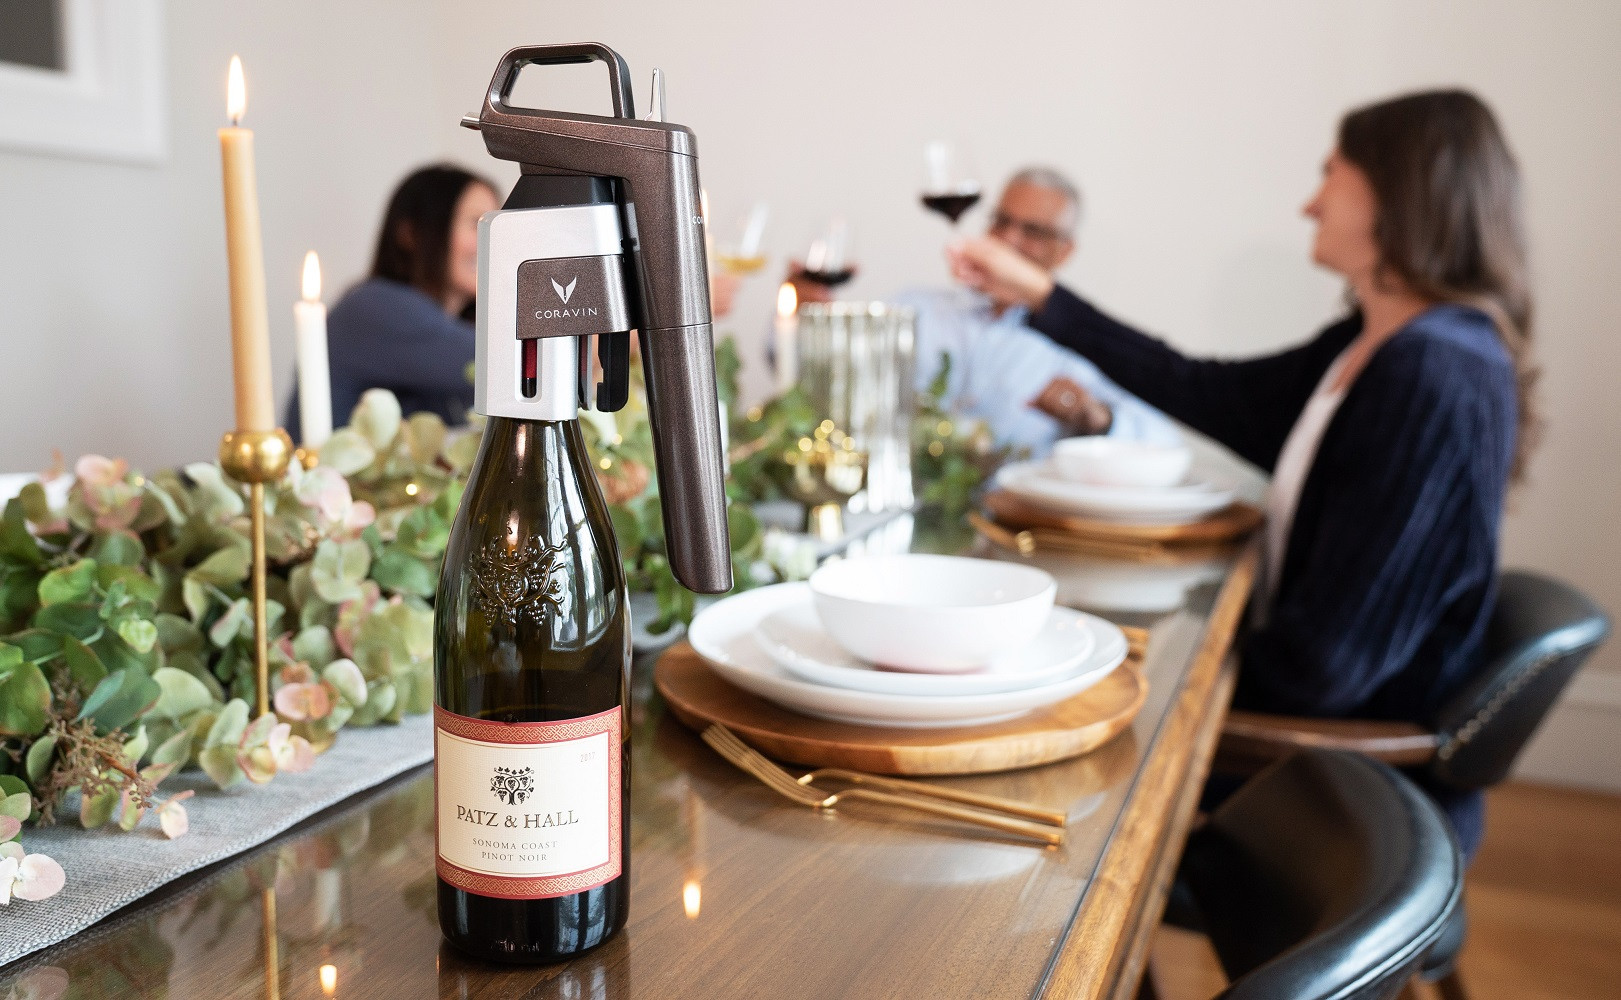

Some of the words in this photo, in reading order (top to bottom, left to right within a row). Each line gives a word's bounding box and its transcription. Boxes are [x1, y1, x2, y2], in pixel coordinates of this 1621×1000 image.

[535, 307, 598, 320] CORAVIN
[580, 751, 596, 763] 2017
[457, 804, 499, 828] PATZ
[504, 815, 517, 829] &
[523, 810, 579, 829] HALL
[472, 837, 517, 850] SONOMA
[521, 840, 558, 850] COAST
[481, 851, 514, 862] PINOT
[519, 853, 547, 862] NOIR
